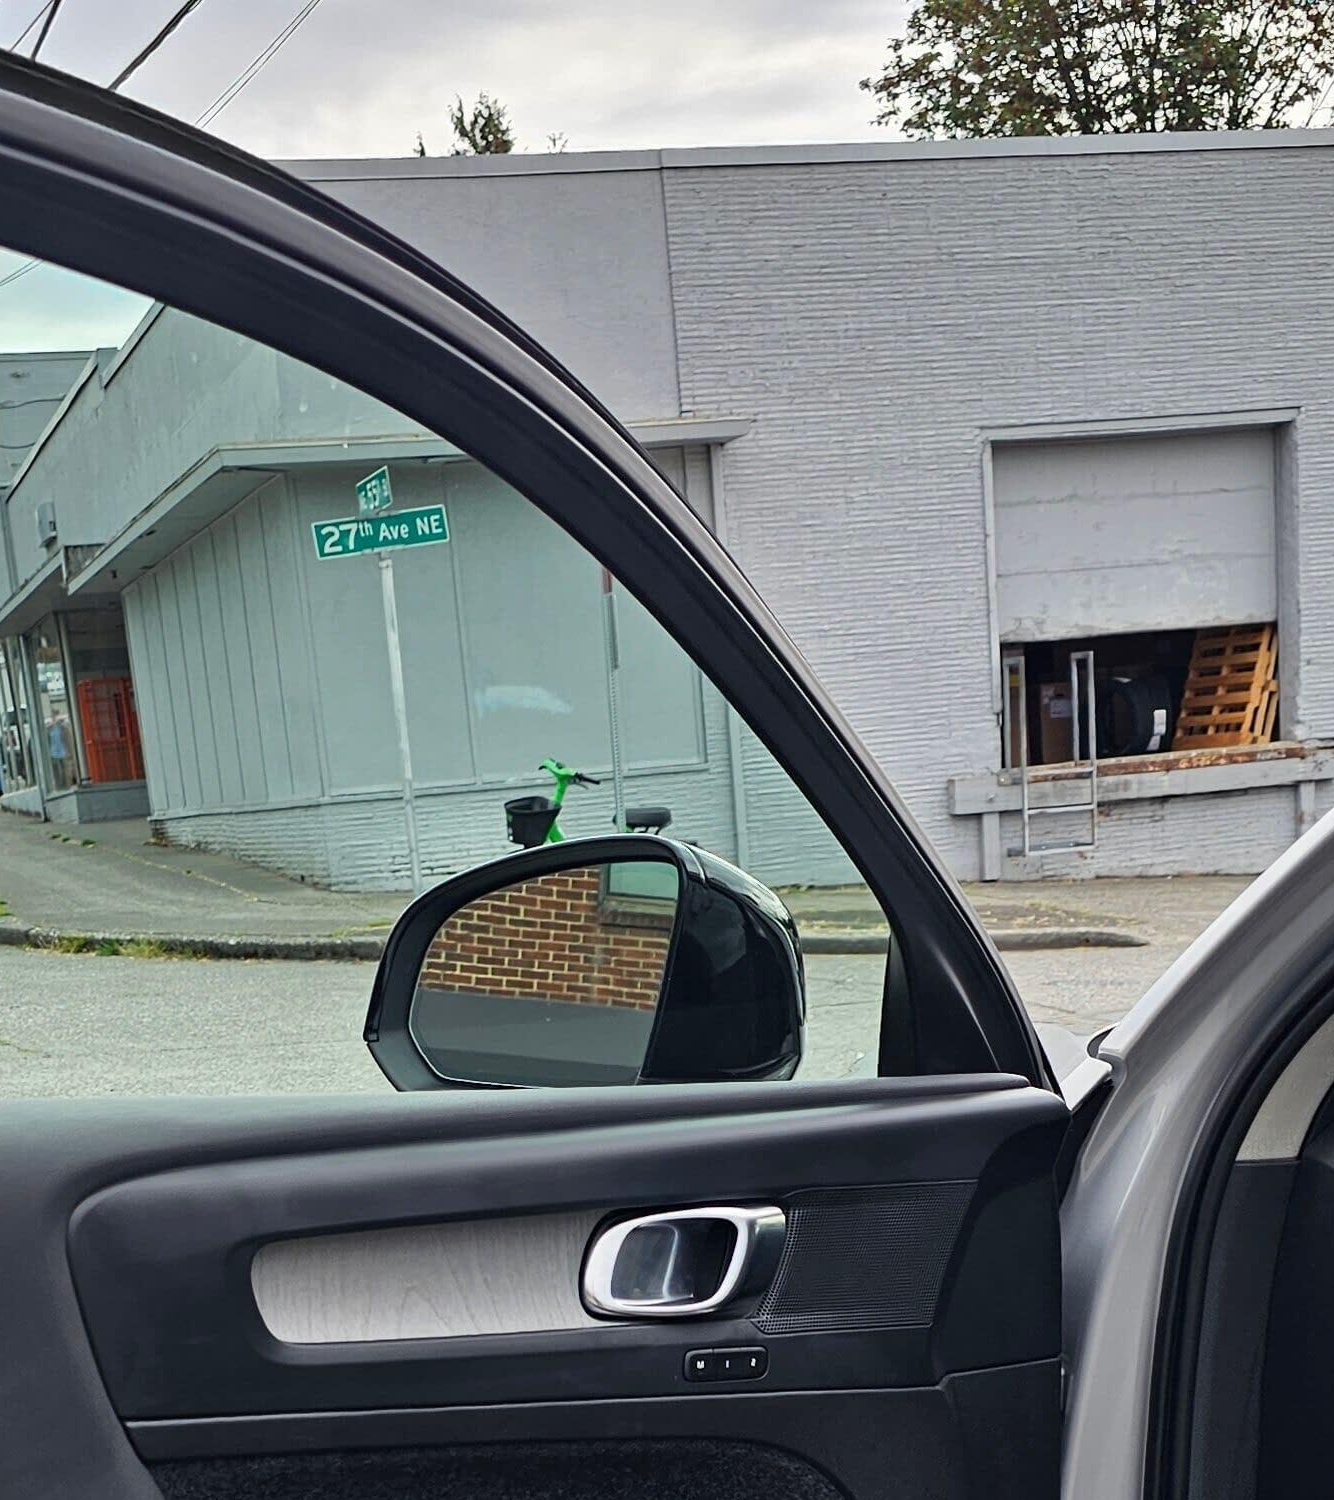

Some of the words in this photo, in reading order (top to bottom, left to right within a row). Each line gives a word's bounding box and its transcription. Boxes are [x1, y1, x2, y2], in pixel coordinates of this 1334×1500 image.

[320, 520, 374, 554] 27th
[379, 522, 409, 543] Ave
[415, 514, 444, 536] NE
[696, 1360, 705, 1369] M
